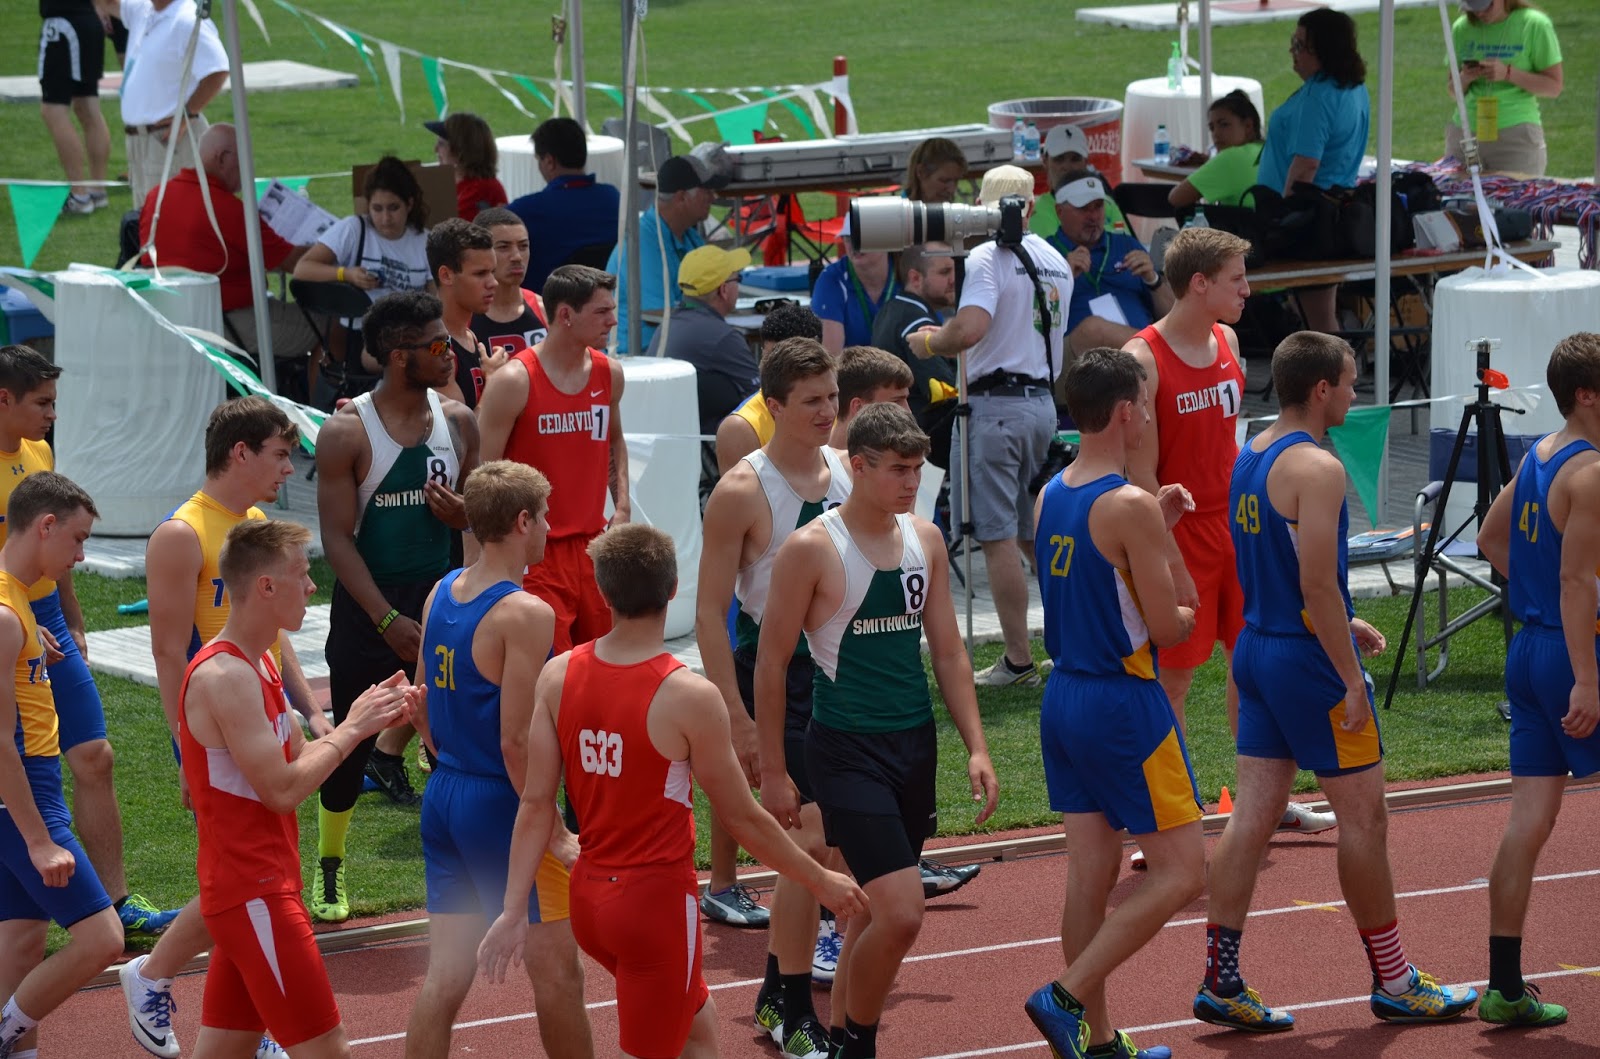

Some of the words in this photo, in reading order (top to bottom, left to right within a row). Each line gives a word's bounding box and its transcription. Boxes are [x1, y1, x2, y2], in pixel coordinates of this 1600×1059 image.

[1223, 383, 1234, 414] 1
[595, 408, 603, 438] 1
[430, 458, 448, 487] 8
[1236, 493, 1261, 534] 49
[1519, 501, 1539, 543] 47
[1050, 534, 1075, 577] 27
[906, 573, 925, 610] 8
[852, 612, 921, 635] SMITHVILLE
[434, 644, 456, 691] 31
[578, 728, 623, 778] 633
